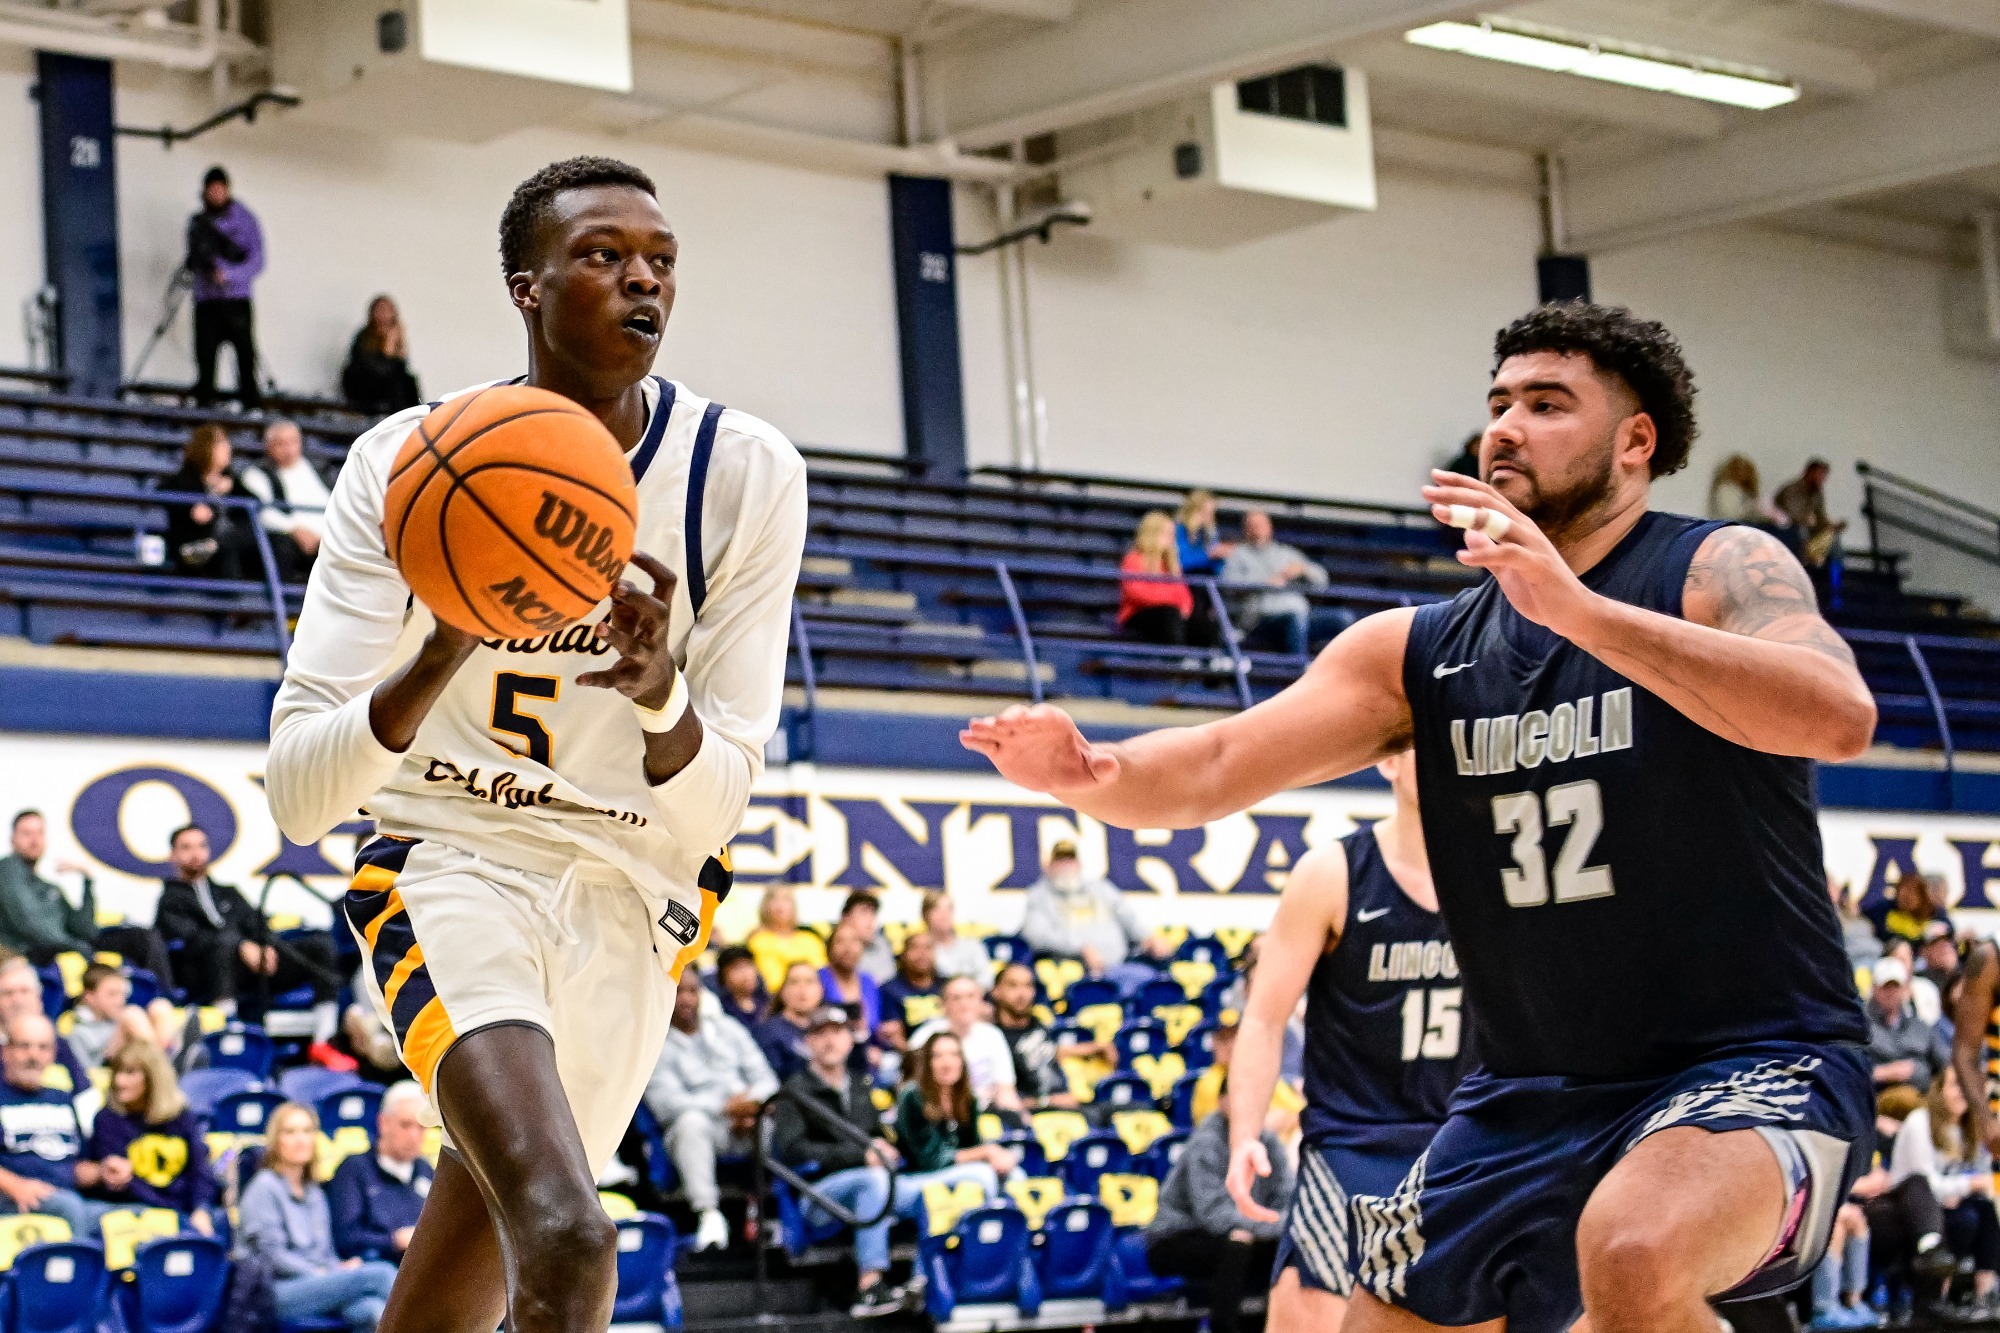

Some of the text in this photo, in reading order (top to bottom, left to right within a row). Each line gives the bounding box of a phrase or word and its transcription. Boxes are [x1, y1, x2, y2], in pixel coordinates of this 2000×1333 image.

[534, 489, 624, 584] Wilso
[488, 669, 561, 770] 5
[1451, 687, 1634, 776] LINCOLN
[1490, 778, 1616, 908] 32
[1401, 986, 1463, 1062] 15
